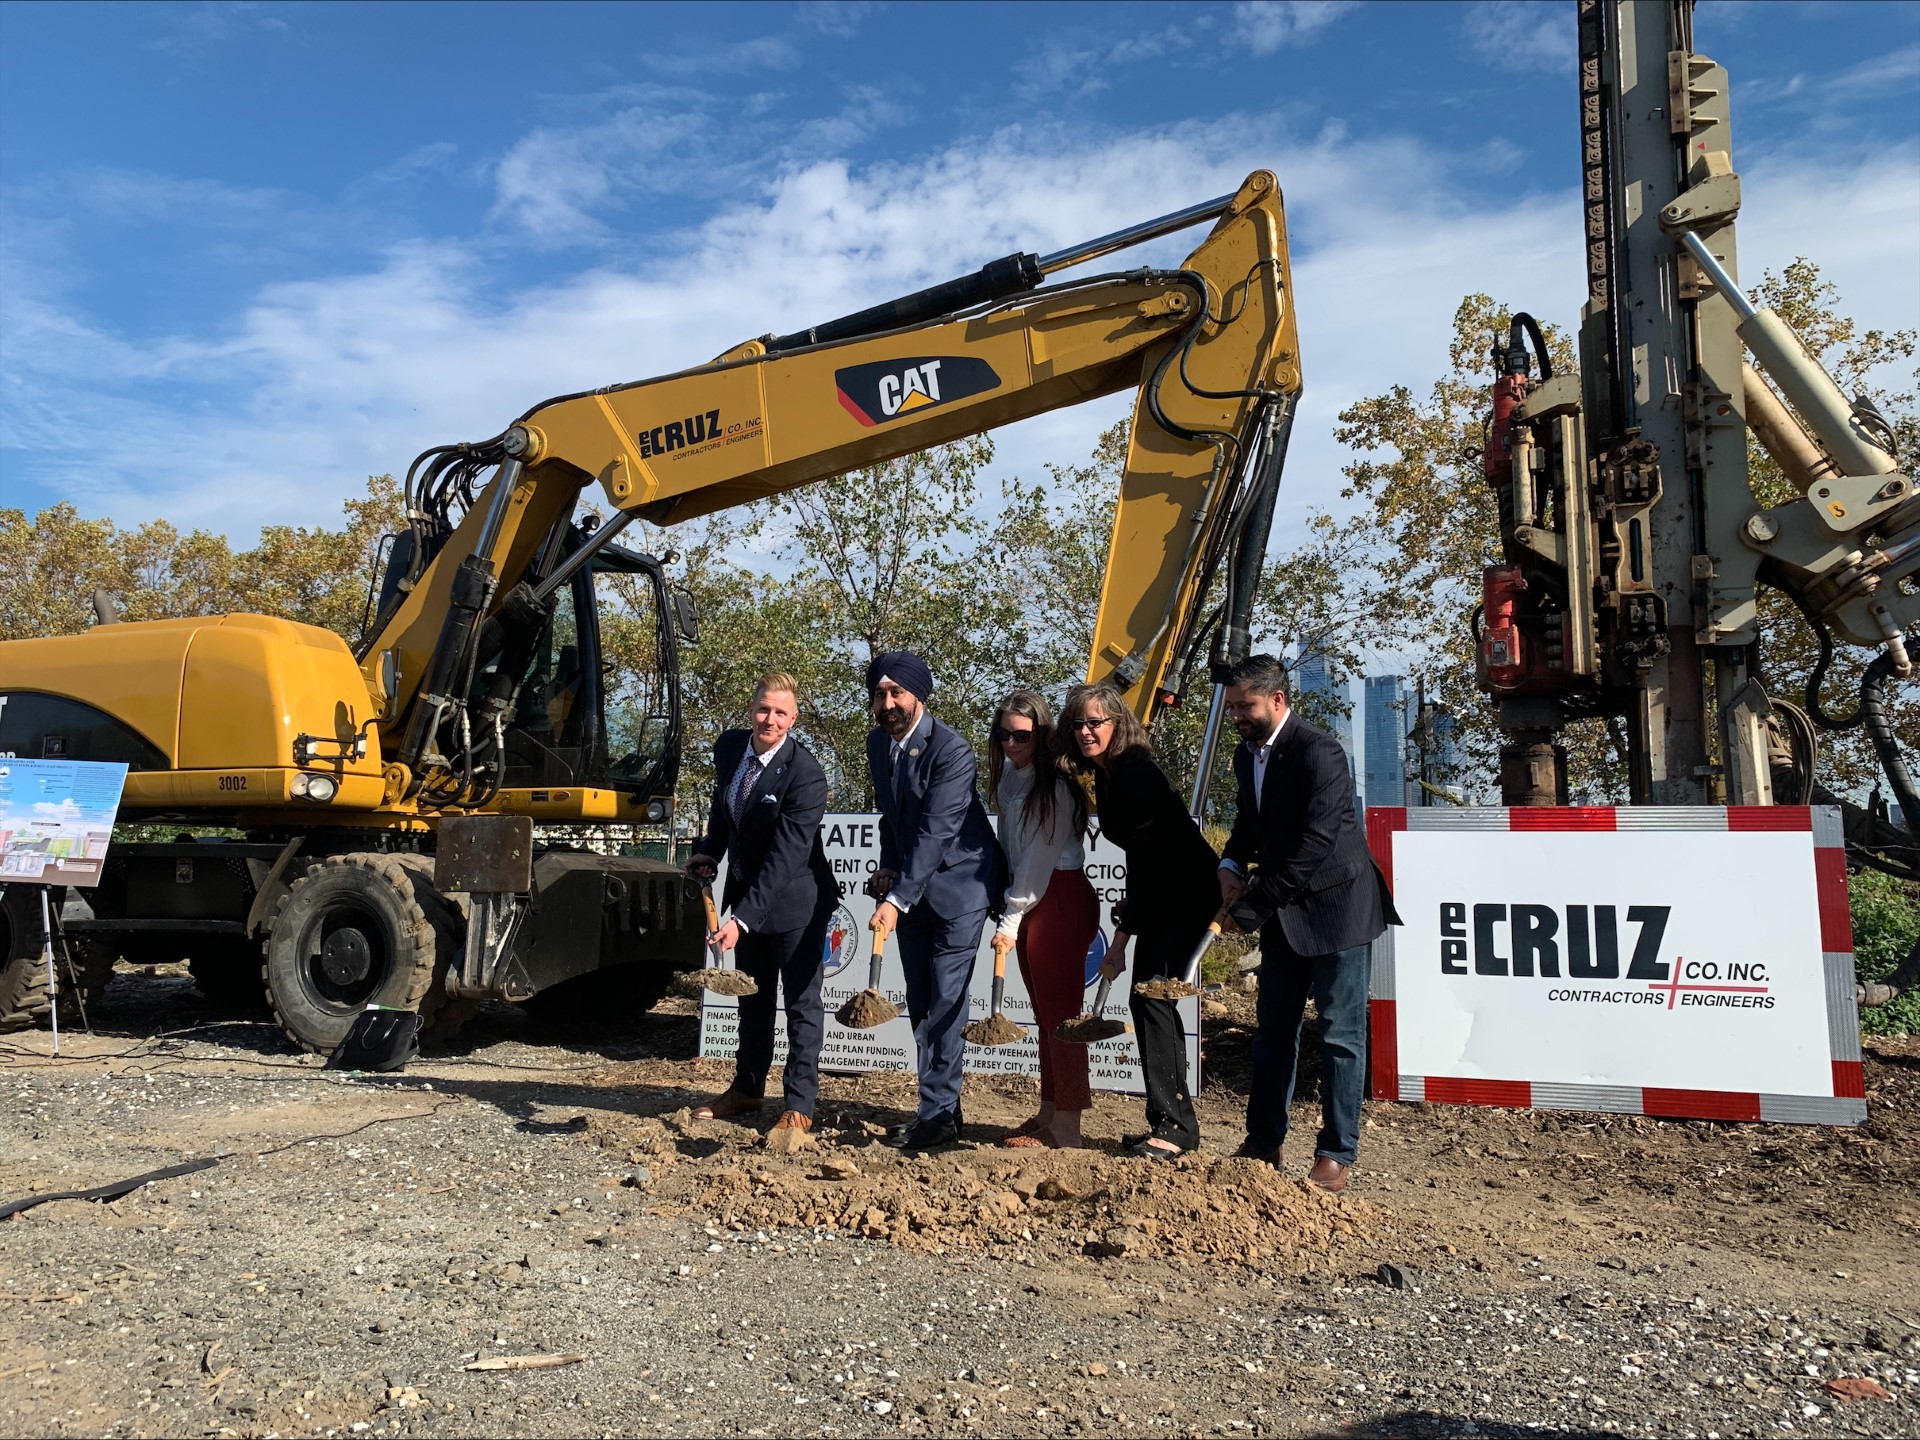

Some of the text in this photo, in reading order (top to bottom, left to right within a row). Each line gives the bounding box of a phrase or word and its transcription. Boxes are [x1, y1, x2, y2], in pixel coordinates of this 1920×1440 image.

[879, 360, 941, 415] CAT
[650, 409, 722, 455] CRUZ
[727, 423, 743, 434] CO.
[746, 417, 764, 428] INC.
[672, 428, 764, 461] CONTRACTORS ENGINEERS
[219, 776, 247, 790] 3002
[819, 824, 873, 848] TATE
[829, 859, 1126, 880] ENT O CTIO
[1096, 888, 1127, 903] ECT
[1473, 903, 1672, 981] CRUZ
[1685, 961, 1722, 980] CO.
[1727, 963, 1770, 982] INC.
[823, 987, 858, 1002] Murph
[886, 990, 906, 1002] Tah
[1003, 996, 1033, 1009] Shaw
[823, 1002, 840, 1010] NOR
[1548, 989, 1775, 1009] CONTRACTORS ENGINEERS
[707, 1011, 741, 1021] FINANCE
[706, 1024, 720, 1032] U.S.
[773, 1028, 784, 1036] OF
[826, 1031, 844, 1039] AND
[847, 1032, 875, 1041] URBAN
[705, 1036, 740, 1046] DEVELOP
[820, 1043, 840, 1053] SCUE
[843, 1045, 863, 1054] PLAN
[866, 1046, 907, 1058] FUNDING;
[963, 1045, 981, 1055] SHIP
[984, 1047, 996, 1056] OF
[1090, 1054, 1101, 1063] RD
[1104, 1056, 1112, 1064] F.
[1114, 1056, 1142, 1067] TURNE
[1095, 1042, 1131, 1051] MAYOR
[704, 1049, 721, 1057] AND
[724, 1050, 736, 1058] FED
[819, 1057, 870, 1068] ANAGEMENT
[872, 1060, 909, 1070] AGENCY
[972, 1060, 1002, 1070] JERSEY
[1004, 1062, 1026, 1072] CITY,
[1028, 1063, 1041, 1073] STE
[1096, 1068, 1132, 1079] MAYOR
